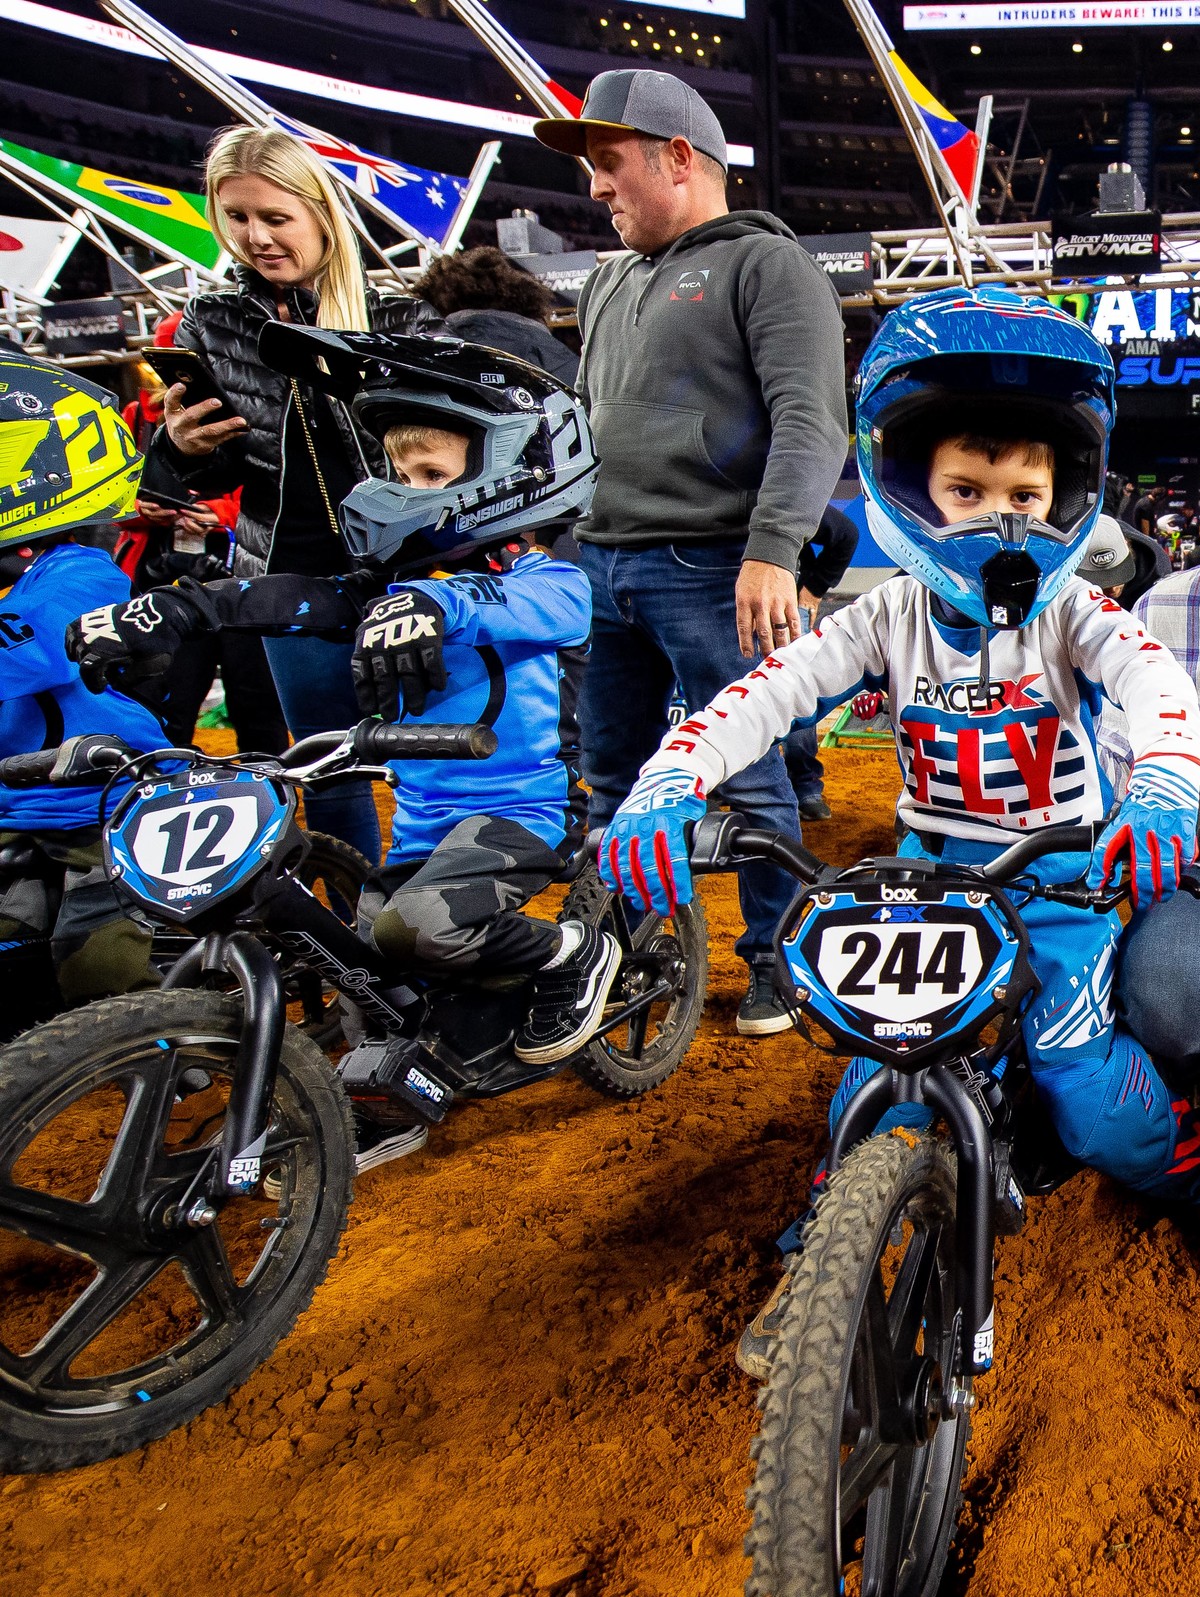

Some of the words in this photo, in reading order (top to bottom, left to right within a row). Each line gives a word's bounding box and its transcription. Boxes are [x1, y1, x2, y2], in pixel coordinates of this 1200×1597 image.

[998, 9, 1076, 20] INTRUDERS
[1082, 8, 1145, 19] BEWARE!
[1152, 7, 1182, 18] THIS
[1189, 7, 1200, 17] IS
[1070, 234, 1101, 244] ROCKY
[1101, 233, 1153, 243] MOUNTAIN
[816, 251, 864, 261] MOUNTAIN
[678, 281, 702, 289] RVCA
[1125, 340, 1160, 356] AMA
[1091, 554, 1114, 563] VANS
[915, 558, 944, 587] RACING
[362, 614, 437, 649] FOX
[901, 716, 1061, 816] FLY
[188, 772, 216, 786] box
[158, 804, 235, 875] 12
[167, 882, 213, 901] STACYC
[880, 883, 918, 902] box
[836, 930, 967, 996] 244
[1033, 997, 1056, 1030] FLY
[873, 1021, 933, 1038] STACYC
[407, 1067, 444, 1103] STACYC
[229, 1157, 261, 1172] STA
[227, 1169, 261, 1185] CYC
